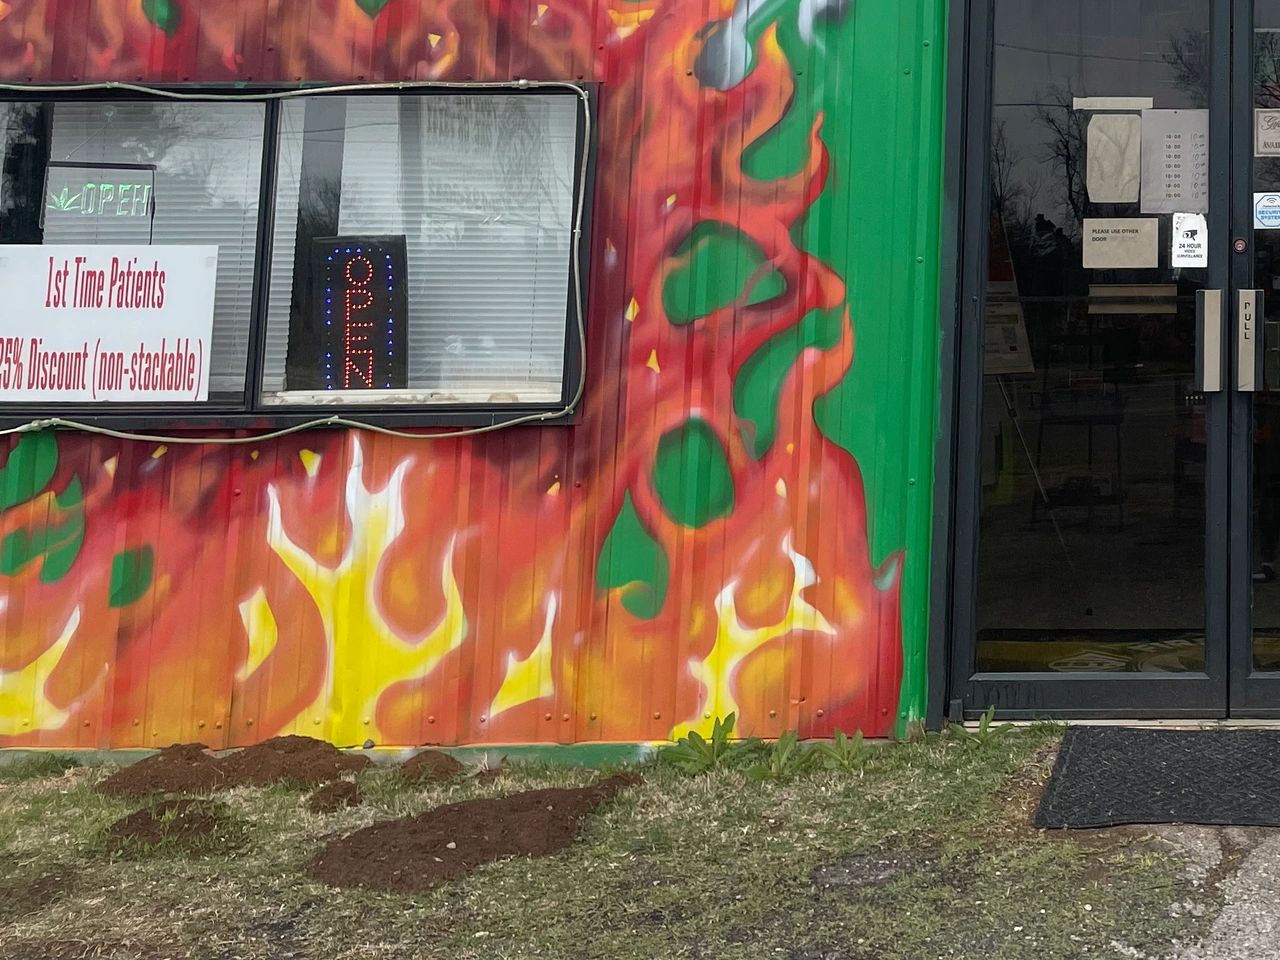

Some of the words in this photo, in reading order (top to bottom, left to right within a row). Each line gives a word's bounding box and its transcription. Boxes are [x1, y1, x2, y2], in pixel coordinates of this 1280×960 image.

[81, 183, 151, 216] OPEN
[45, 256, 69, 308] 1st
[73, 256, 105, 308] Time
[108, 257, 166, 308] Patients
[344, 255, 374, 389] OPEN
[27, 338, 88, 390] Discount
[93, 338, 203, 401] (non-stackable)
